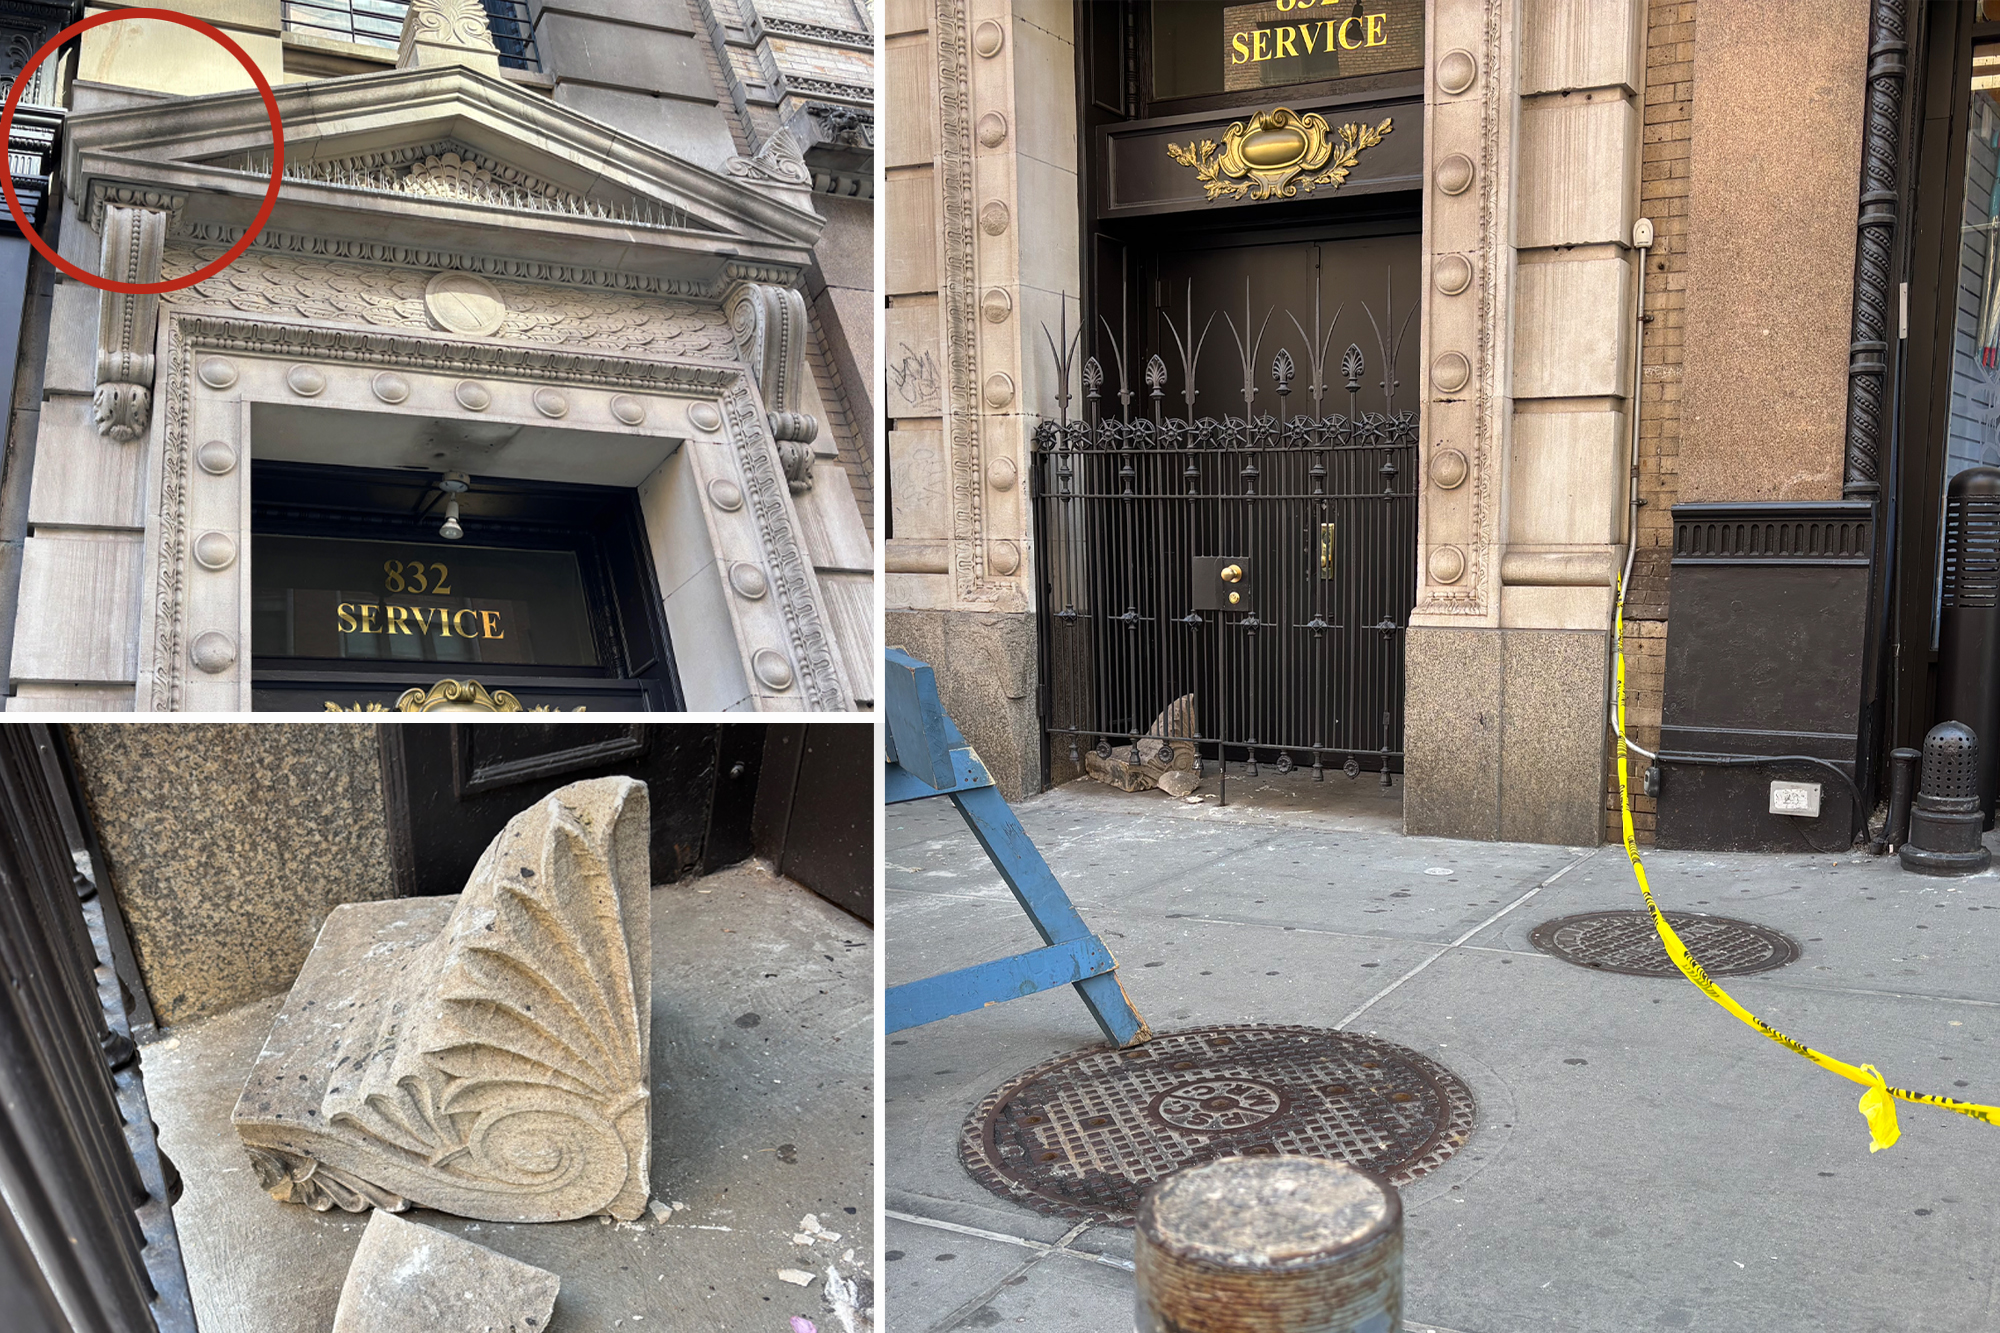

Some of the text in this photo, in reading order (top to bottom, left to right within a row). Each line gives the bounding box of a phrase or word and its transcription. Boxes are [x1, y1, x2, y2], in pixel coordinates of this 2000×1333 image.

[1232, 13, 1388, 65] SERVICE
[384, 560, 451, 594] 832
[337, 602, 504, 640] SERVICE
